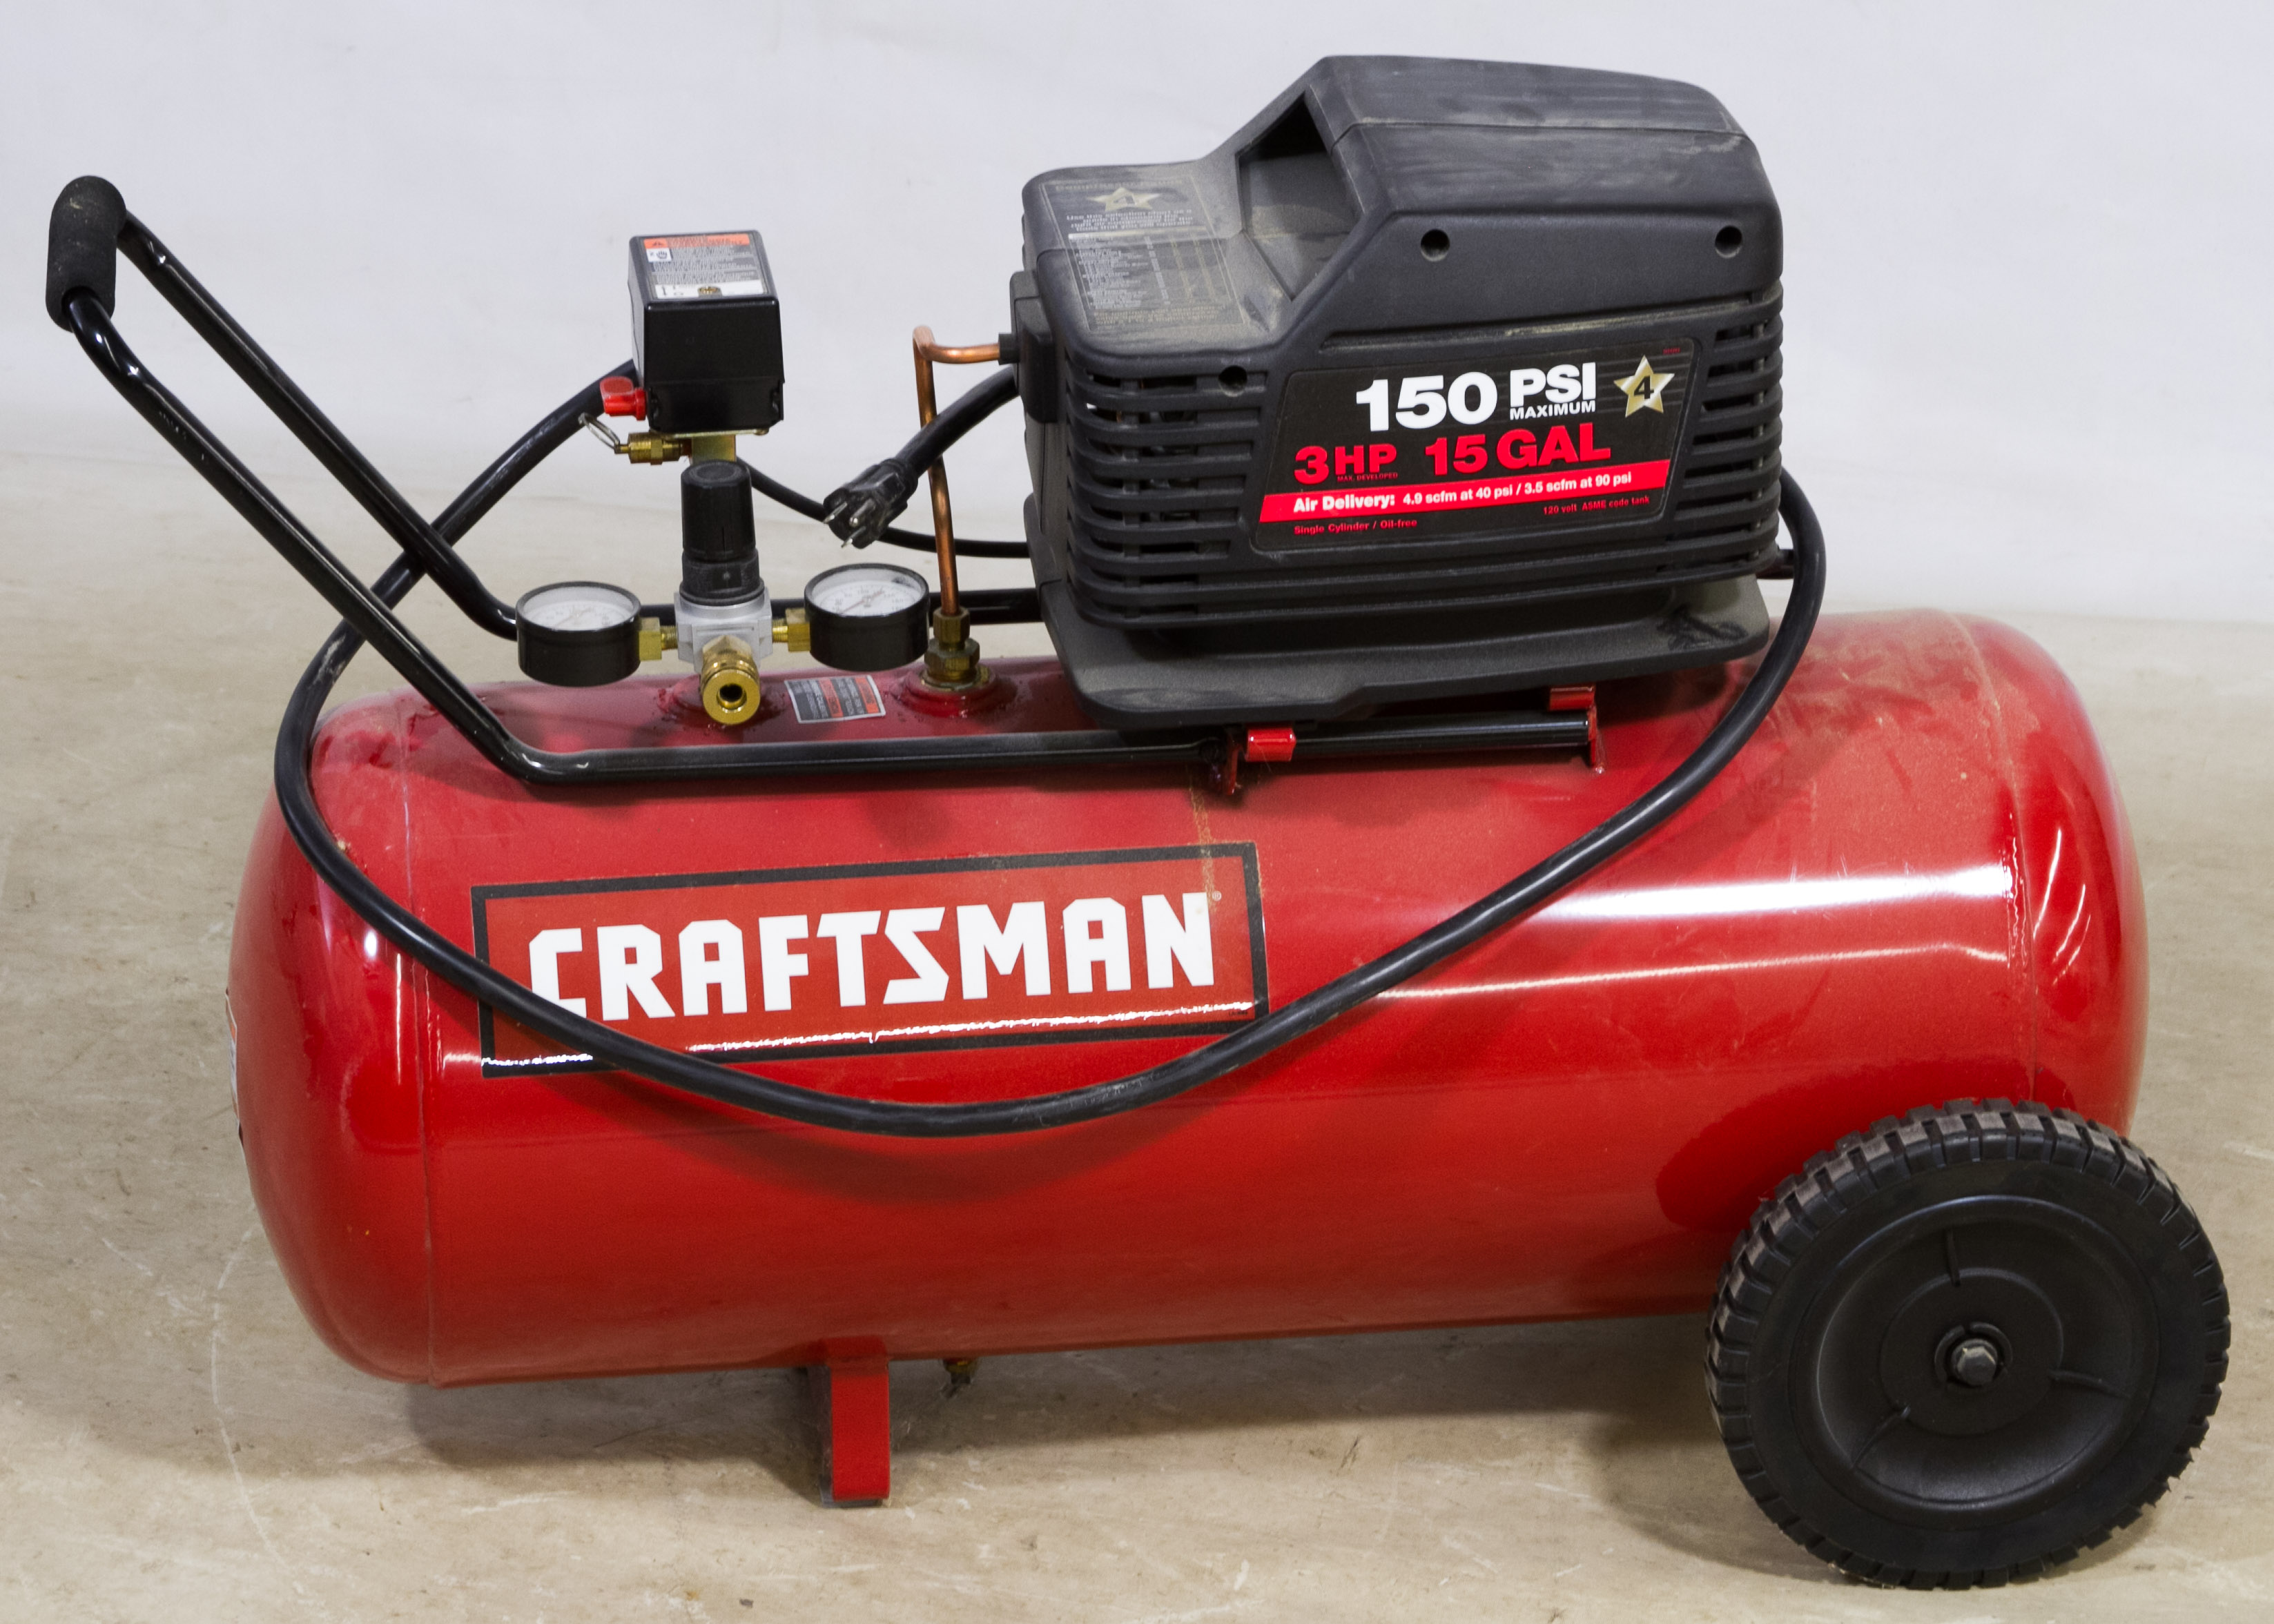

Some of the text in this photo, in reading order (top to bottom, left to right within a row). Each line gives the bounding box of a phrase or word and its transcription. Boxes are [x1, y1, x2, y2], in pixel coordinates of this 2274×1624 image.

[1357, 362, 1595, 431] 150 PSI
[1633, 375, 1654, 400] 4
[1510, 400, 1595, 420] MAXIMUM
[1357, 472, 1398, 481] DEVELOPED
[1294, 498, 1318, 512] Air
[1323, 494, 1394, 510] Delivery:
[1403, 493, 1422, 505] 4.9
[1426, 490, 1457, 503] scfm
[1461, 489, 1473, 500] at
[1476, 487, 1491, 498] 40
[1495, 484, 1513, 499] psi
[1524, 482, 1543, 494] 3.5
[1546, 478, 1577, 491] scfm
[1580, 477, 1593, 488] at
[1595, 474, 1611, 486] 90
[1613, 471, 1631, 487] psi
[1543, 495, 1649, 515] 120 volt ASME code tank
[1294, 525, 1324, 536] Single
[1328, 520, 1370, 534] Cylinder
[1379, 519, 1417, 530] Oil-free
[529, 892, 1214, 1021] CRAFTSMAN
